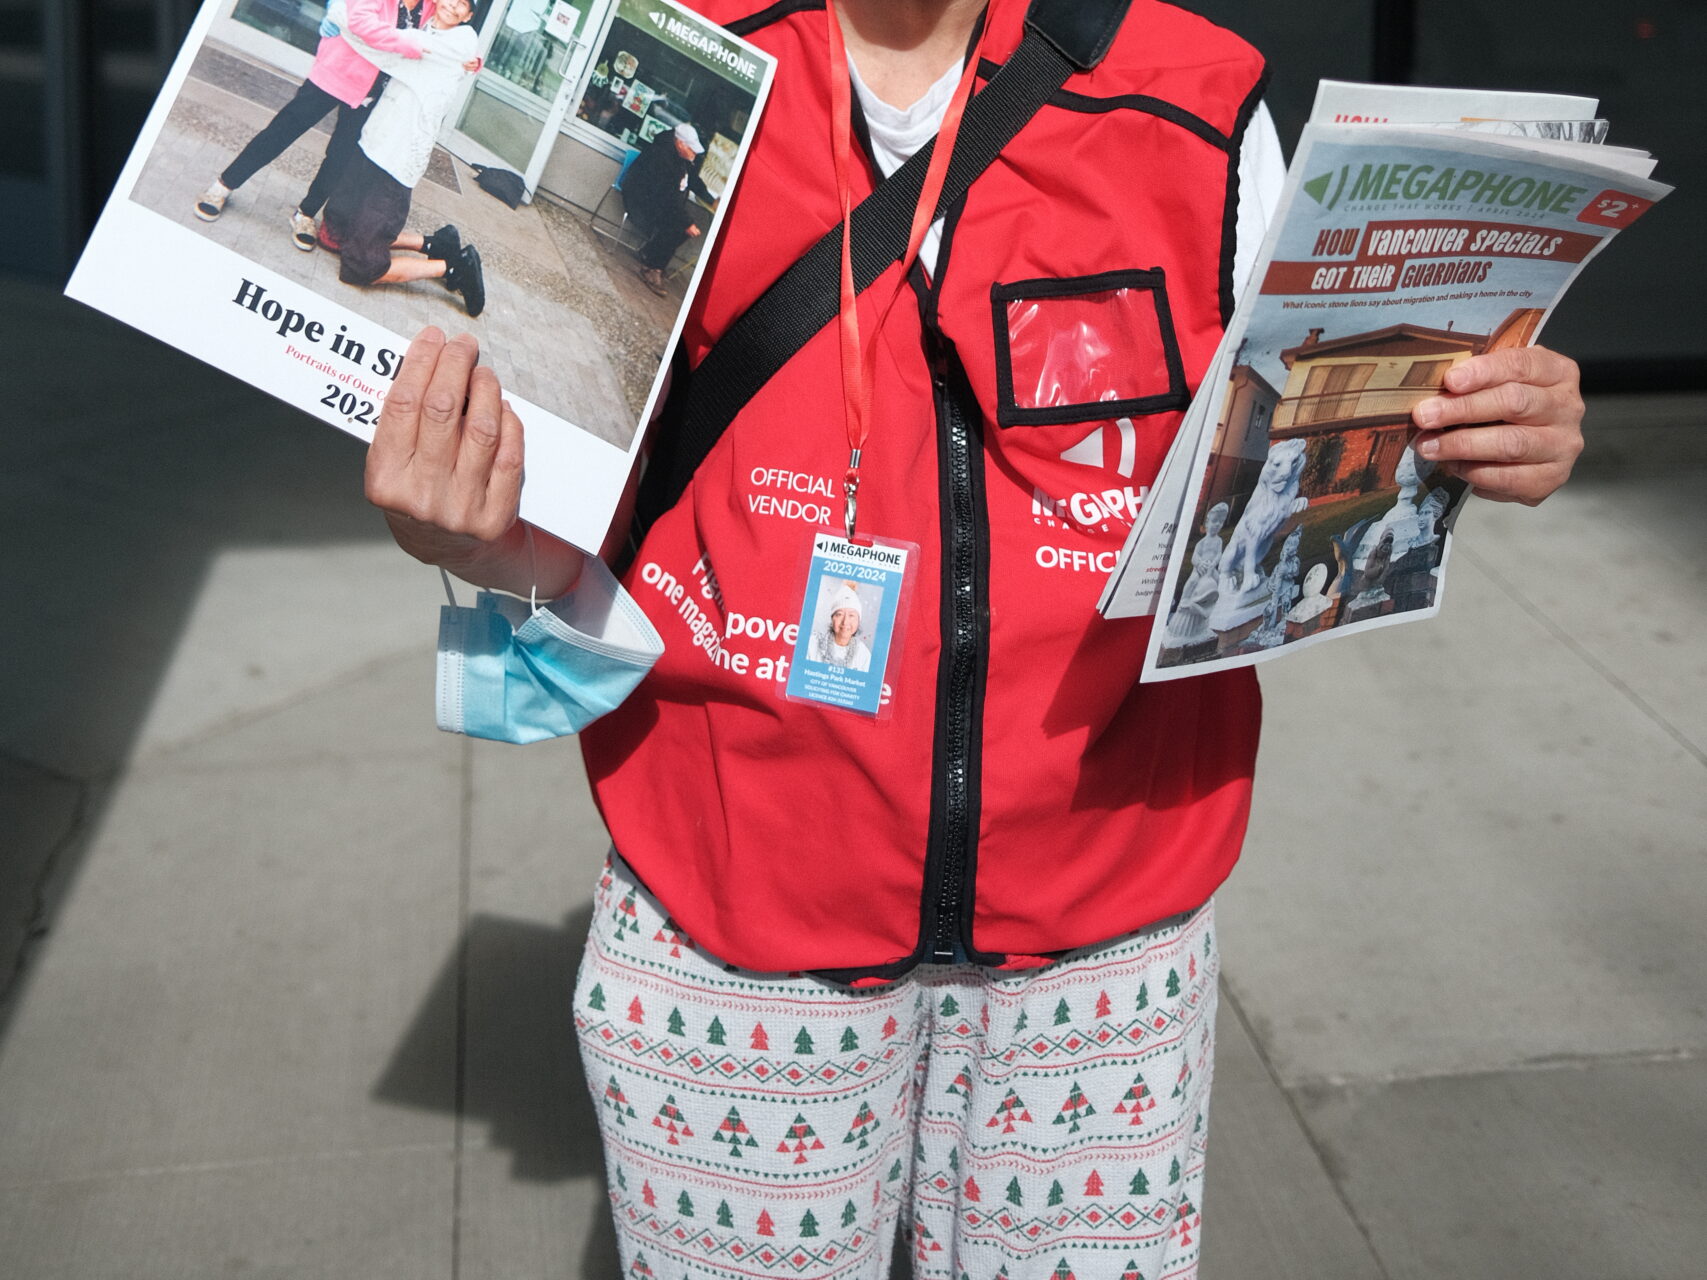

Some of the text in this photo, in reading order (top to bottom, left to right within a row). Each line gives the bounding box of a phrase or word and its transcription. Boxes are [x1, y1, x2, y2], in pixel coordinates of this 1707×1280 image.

[666, 17, 758, 80] MEGAPHONE
[1348, 163, 1588, 215] MEGAPHONE
[1344, 203, 1387, 213] CHANGE
[1393, 202, 1419, 210] THAT
[1424, 203, 1462, 212] WORKS
[1478, 206, 1511, 216] APRIL
[1312, 227, 1360, 257] HOW
[1311, 266, 1347, 291] GOT
[1282, 300, 1303, 310] What
[1304, 300, 1327, 310] iconic
[1328, 301, 1348, 309] stone
[1349, 299, 1367, 308] lions
[1368, 299, 1380, 309] say
[1381, 297, 1402, 306] about
[1402, 294, 1436, 306] migration
[1436, 292, 1449, 301] and
[1450, 289, 1475, 300] making
[1479, 288, 1499, 298] home
[1499, 288, 1505, 297] in
[1507, 288, 1518, 297] the
[1519, 288, 1534, 299] city
[232, 277, 325, 343] Hope
[329, 324, 366, 366] in
[284, 344, 338, 378] Portraits
[338, 373, 353, 384] of
[352, 377, 376, 396] Our
[750, 466, 836, 499] OFFICIAL
[748, 493, 831, 526] VENDOR
[829, 541, 902, 566] MEGAPHONE
[822, 559, 887, 582] 2023/2024
[641, 562, 685, 606] one
[755, 655, 790, 682] at
[725, 611, 799, 646] pove
[804, 668, 866, 687] Hastings Park Market
